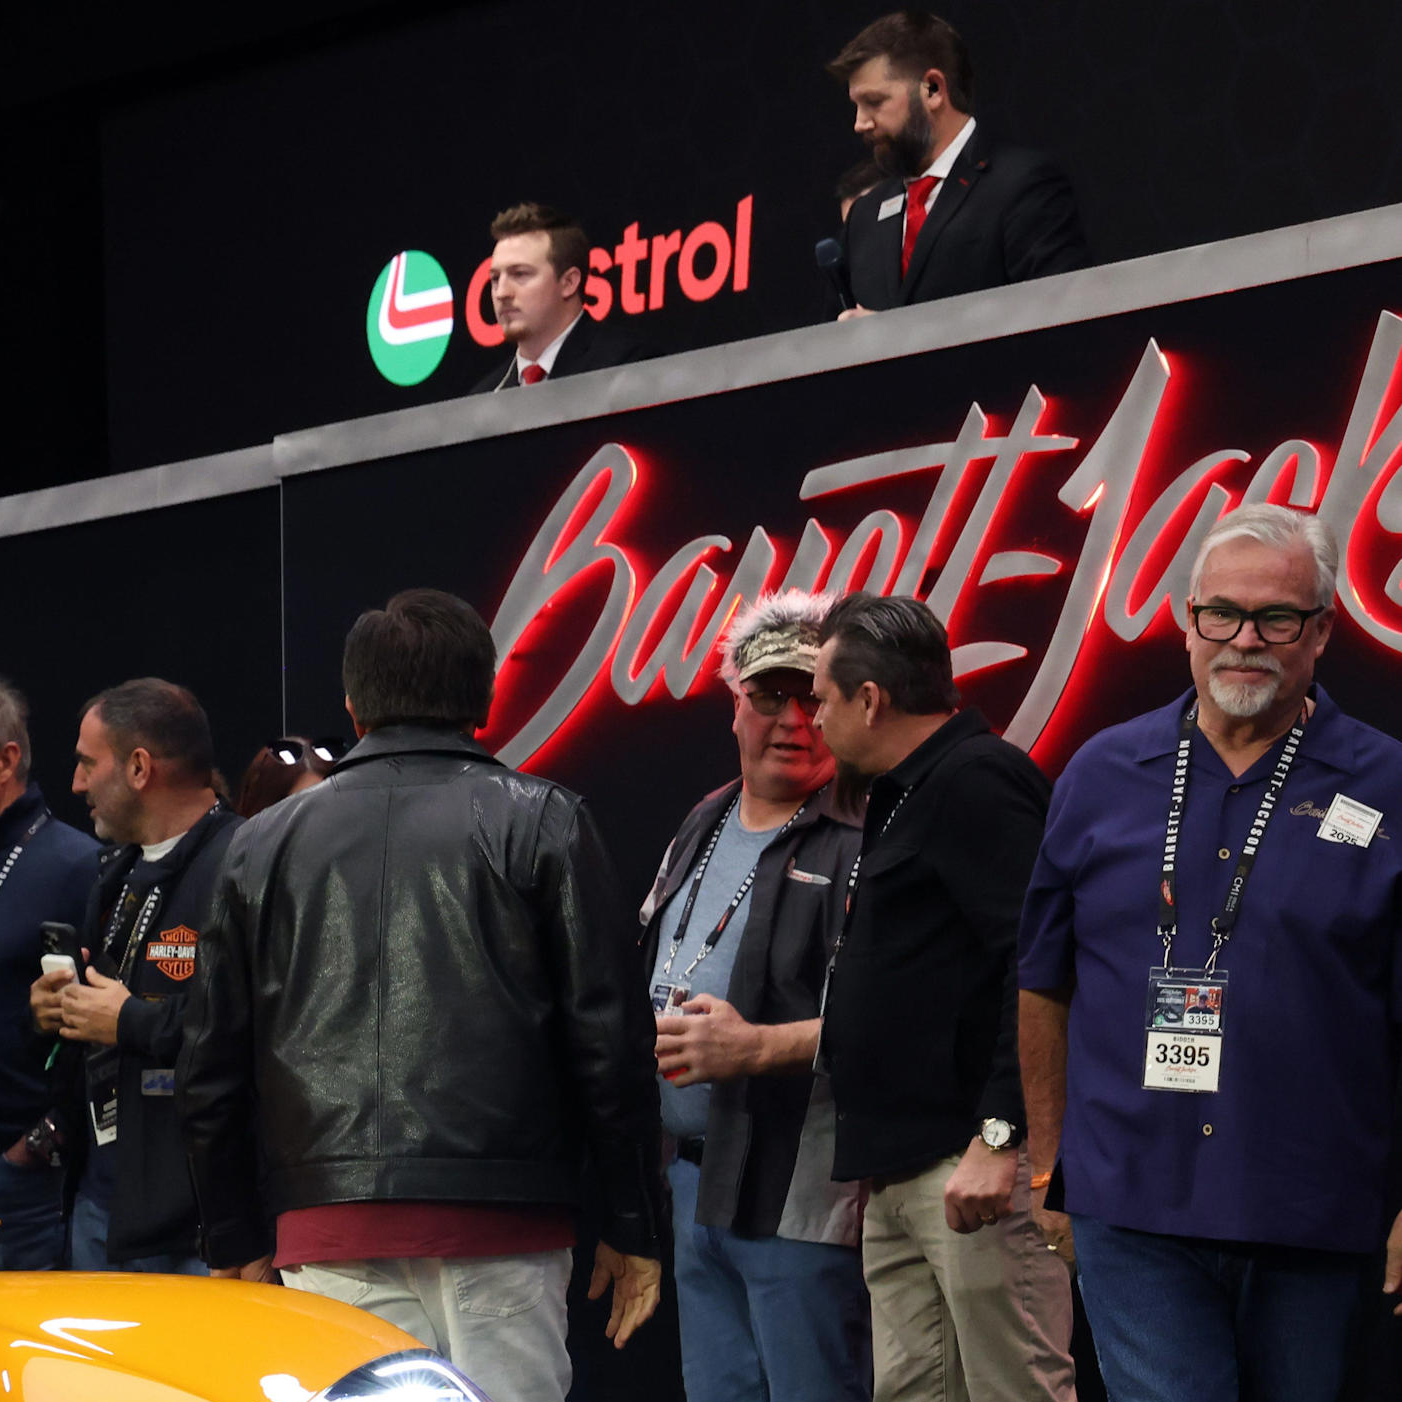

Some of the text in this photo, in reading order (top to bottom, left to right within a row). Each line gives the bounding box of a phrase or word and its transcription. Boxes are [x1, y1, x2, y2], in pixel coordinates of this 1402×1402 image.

[465, 193, 754, 348] Cstrol
[1162, 739, 1191, 872] BARRETT-JACKSON
[1242, 726, 1304, 857] BARRETT-JACKSON
[1230, 876, 1244, 896] CMI
[1155, 1042, 1210, 1068] 3395
[1188, 1014, 1215, 1026] 3395
